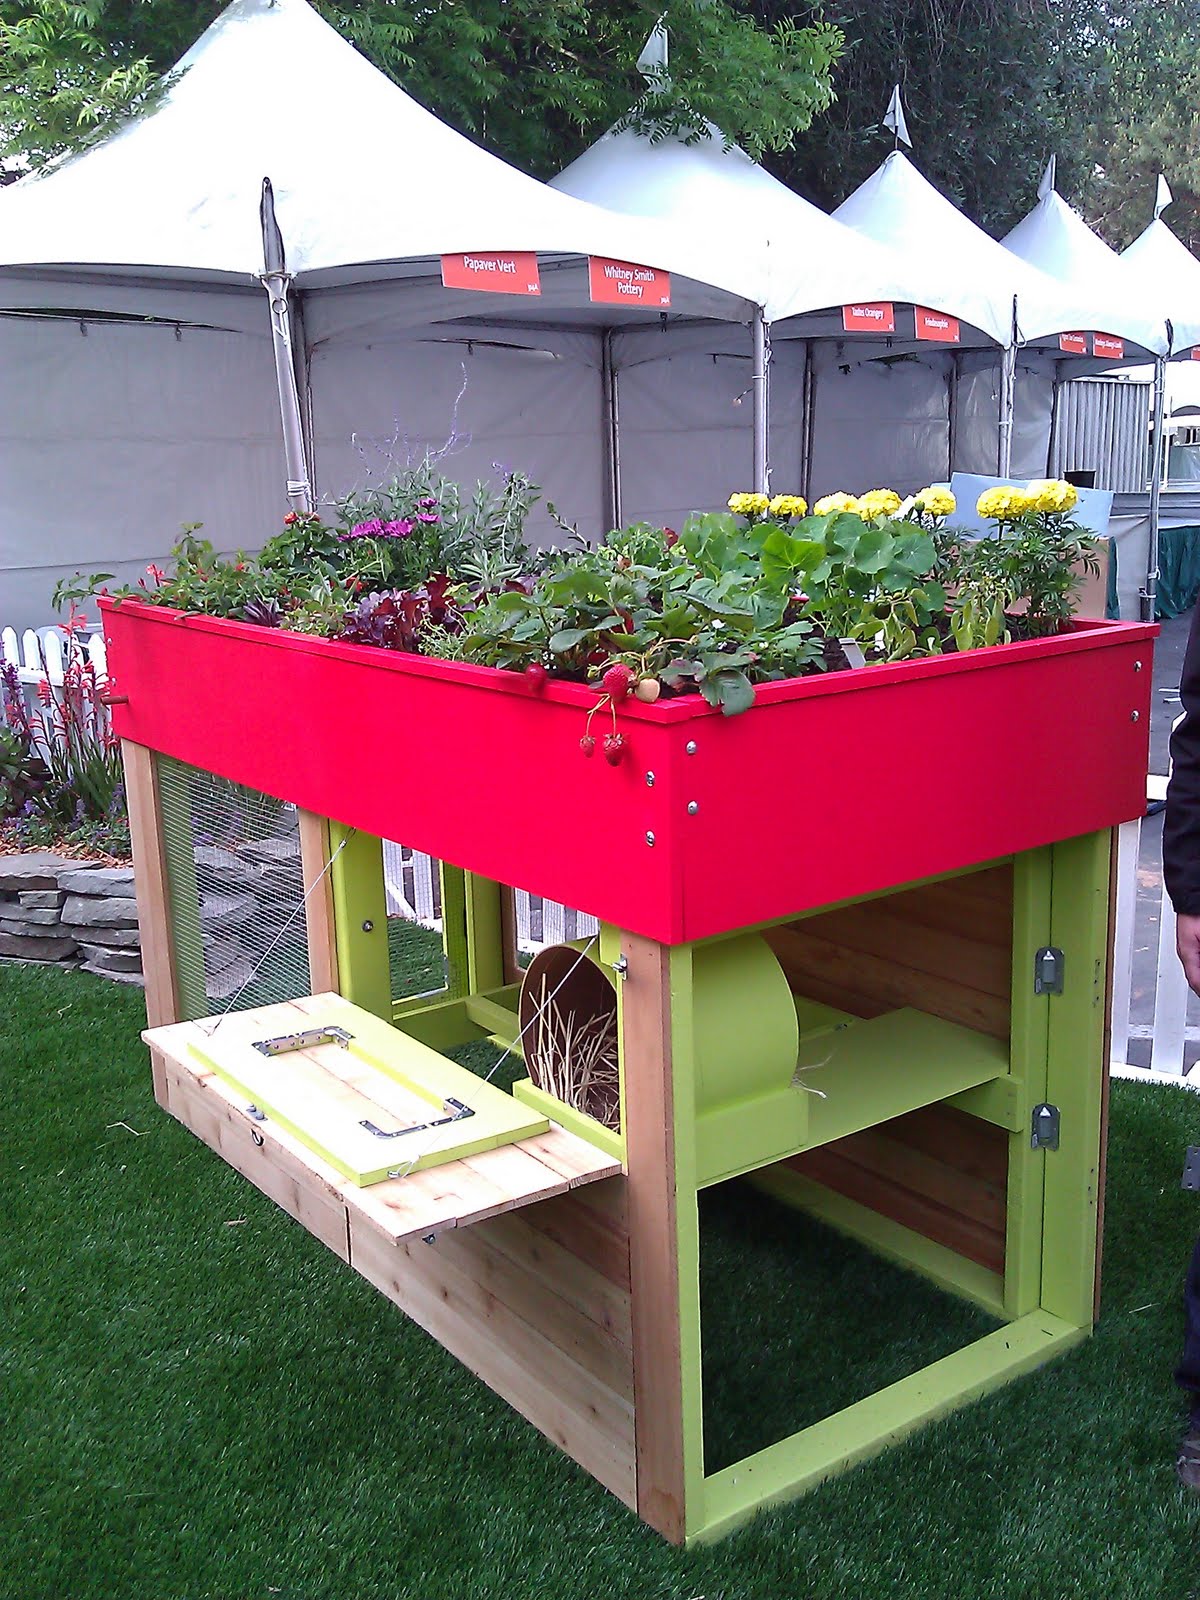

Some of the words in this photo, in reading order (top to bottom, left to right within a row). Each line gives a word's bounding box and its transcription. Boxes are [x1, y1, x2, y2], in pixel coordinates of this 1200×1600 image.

[463, 256, 496, 272] Papaver
[497, 259, 516, 273] Vert
[604, 266, 633, 283] Whitney
[634, 269, 655, 281] Smith
[617, 281, 643, 298] Pottery
